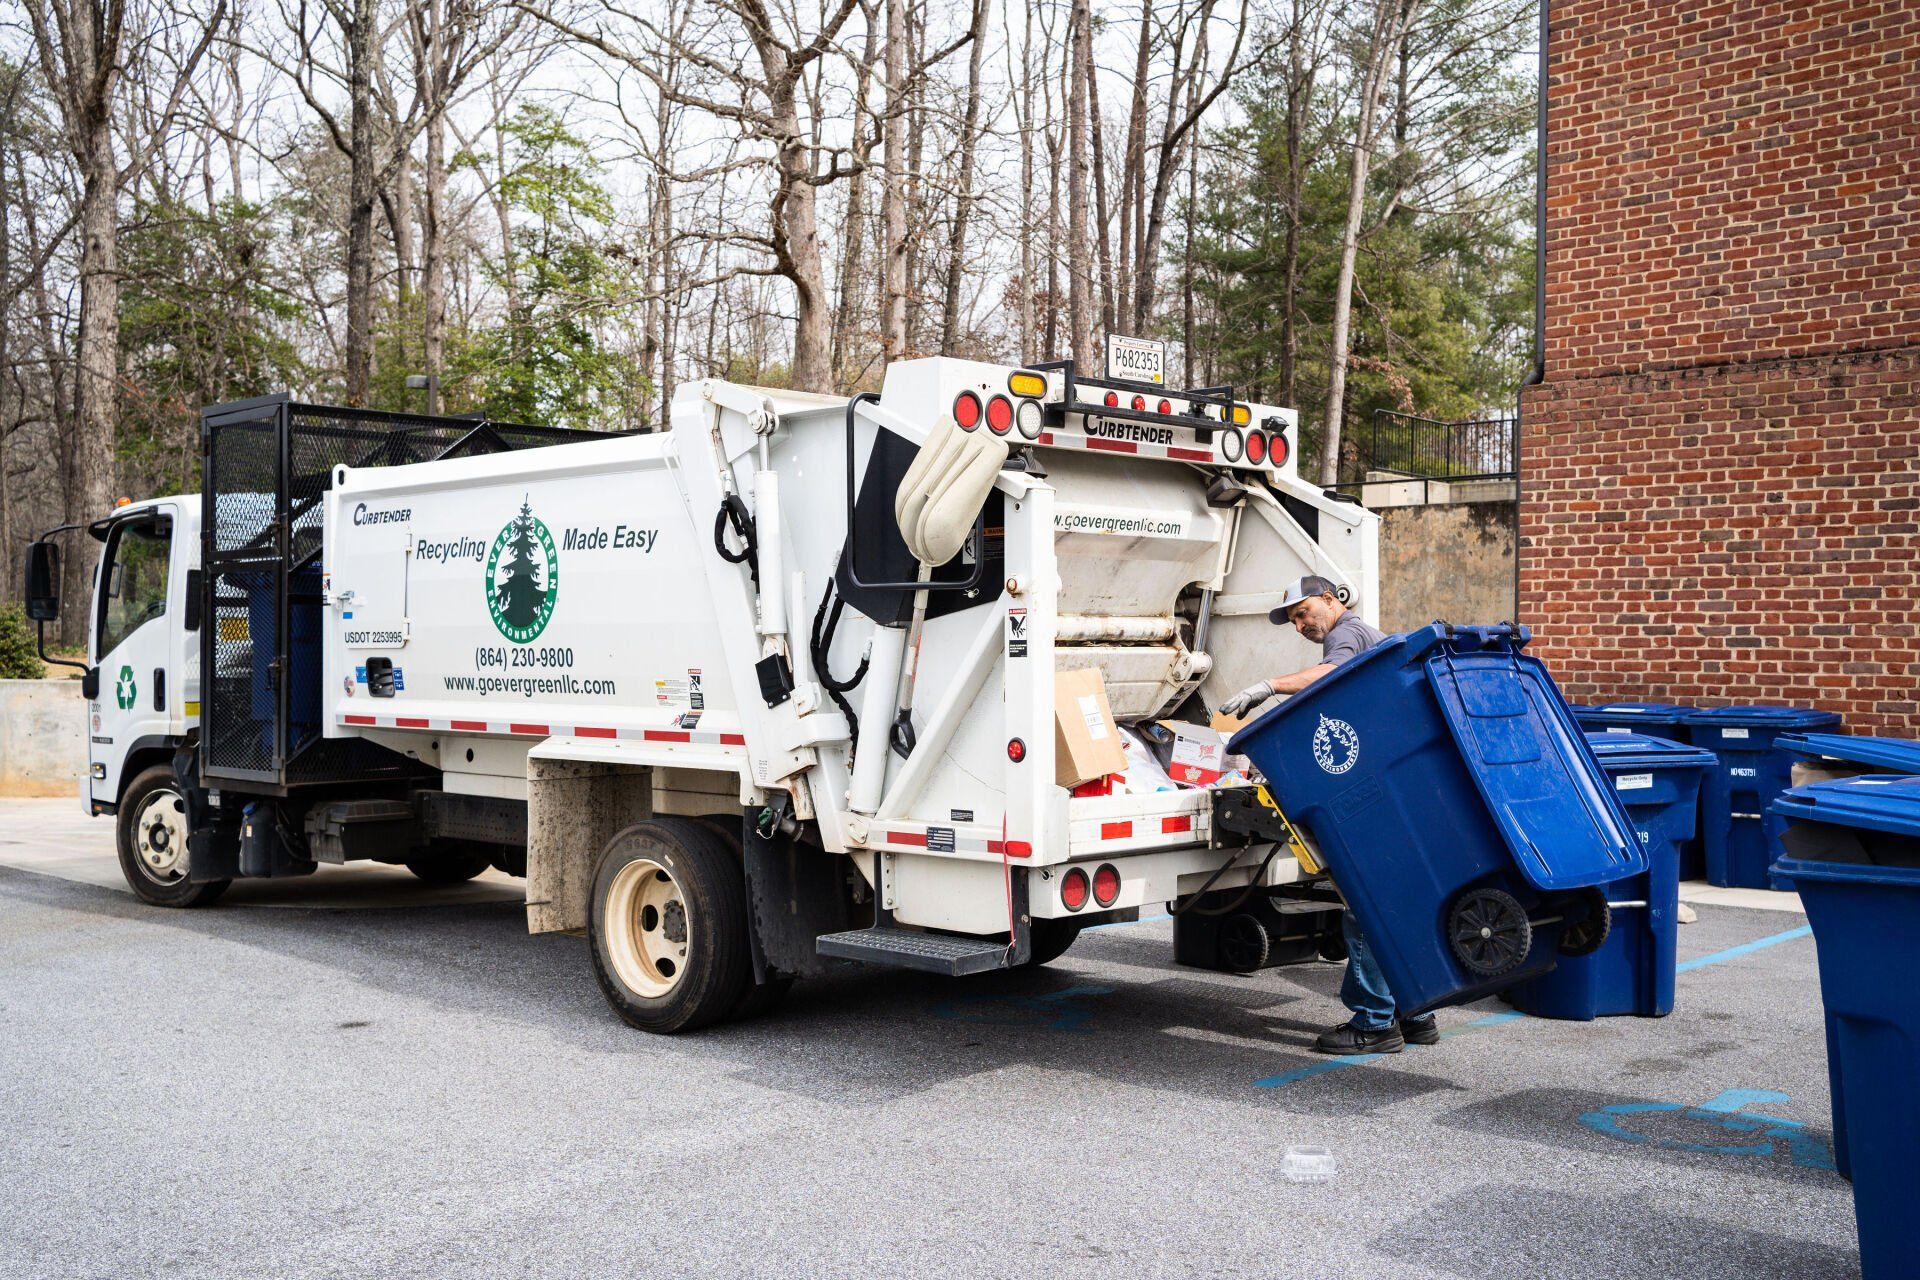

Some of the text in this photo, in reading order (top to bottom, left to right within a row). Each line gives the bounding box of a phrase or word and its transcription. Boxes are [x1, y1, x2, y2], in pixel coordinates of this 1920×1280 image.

[1115, 347, 1159, 371] P682353
[1083, 413, 1173, 445] CURBTENDER
[353, 503, 411, 526] CURBTENDER
[416, 536, 486, 564] Recycling
[562, 524, 658, 554] Made Easy
[487, 589, 554, 640] ENVIRONMENTAL
[344, 631, 403, 643] USDOT 2253995
[475, 647, 574, 671] (864) 230-9800
[444, 674, 616, 697] www.goevergreenllc.com
